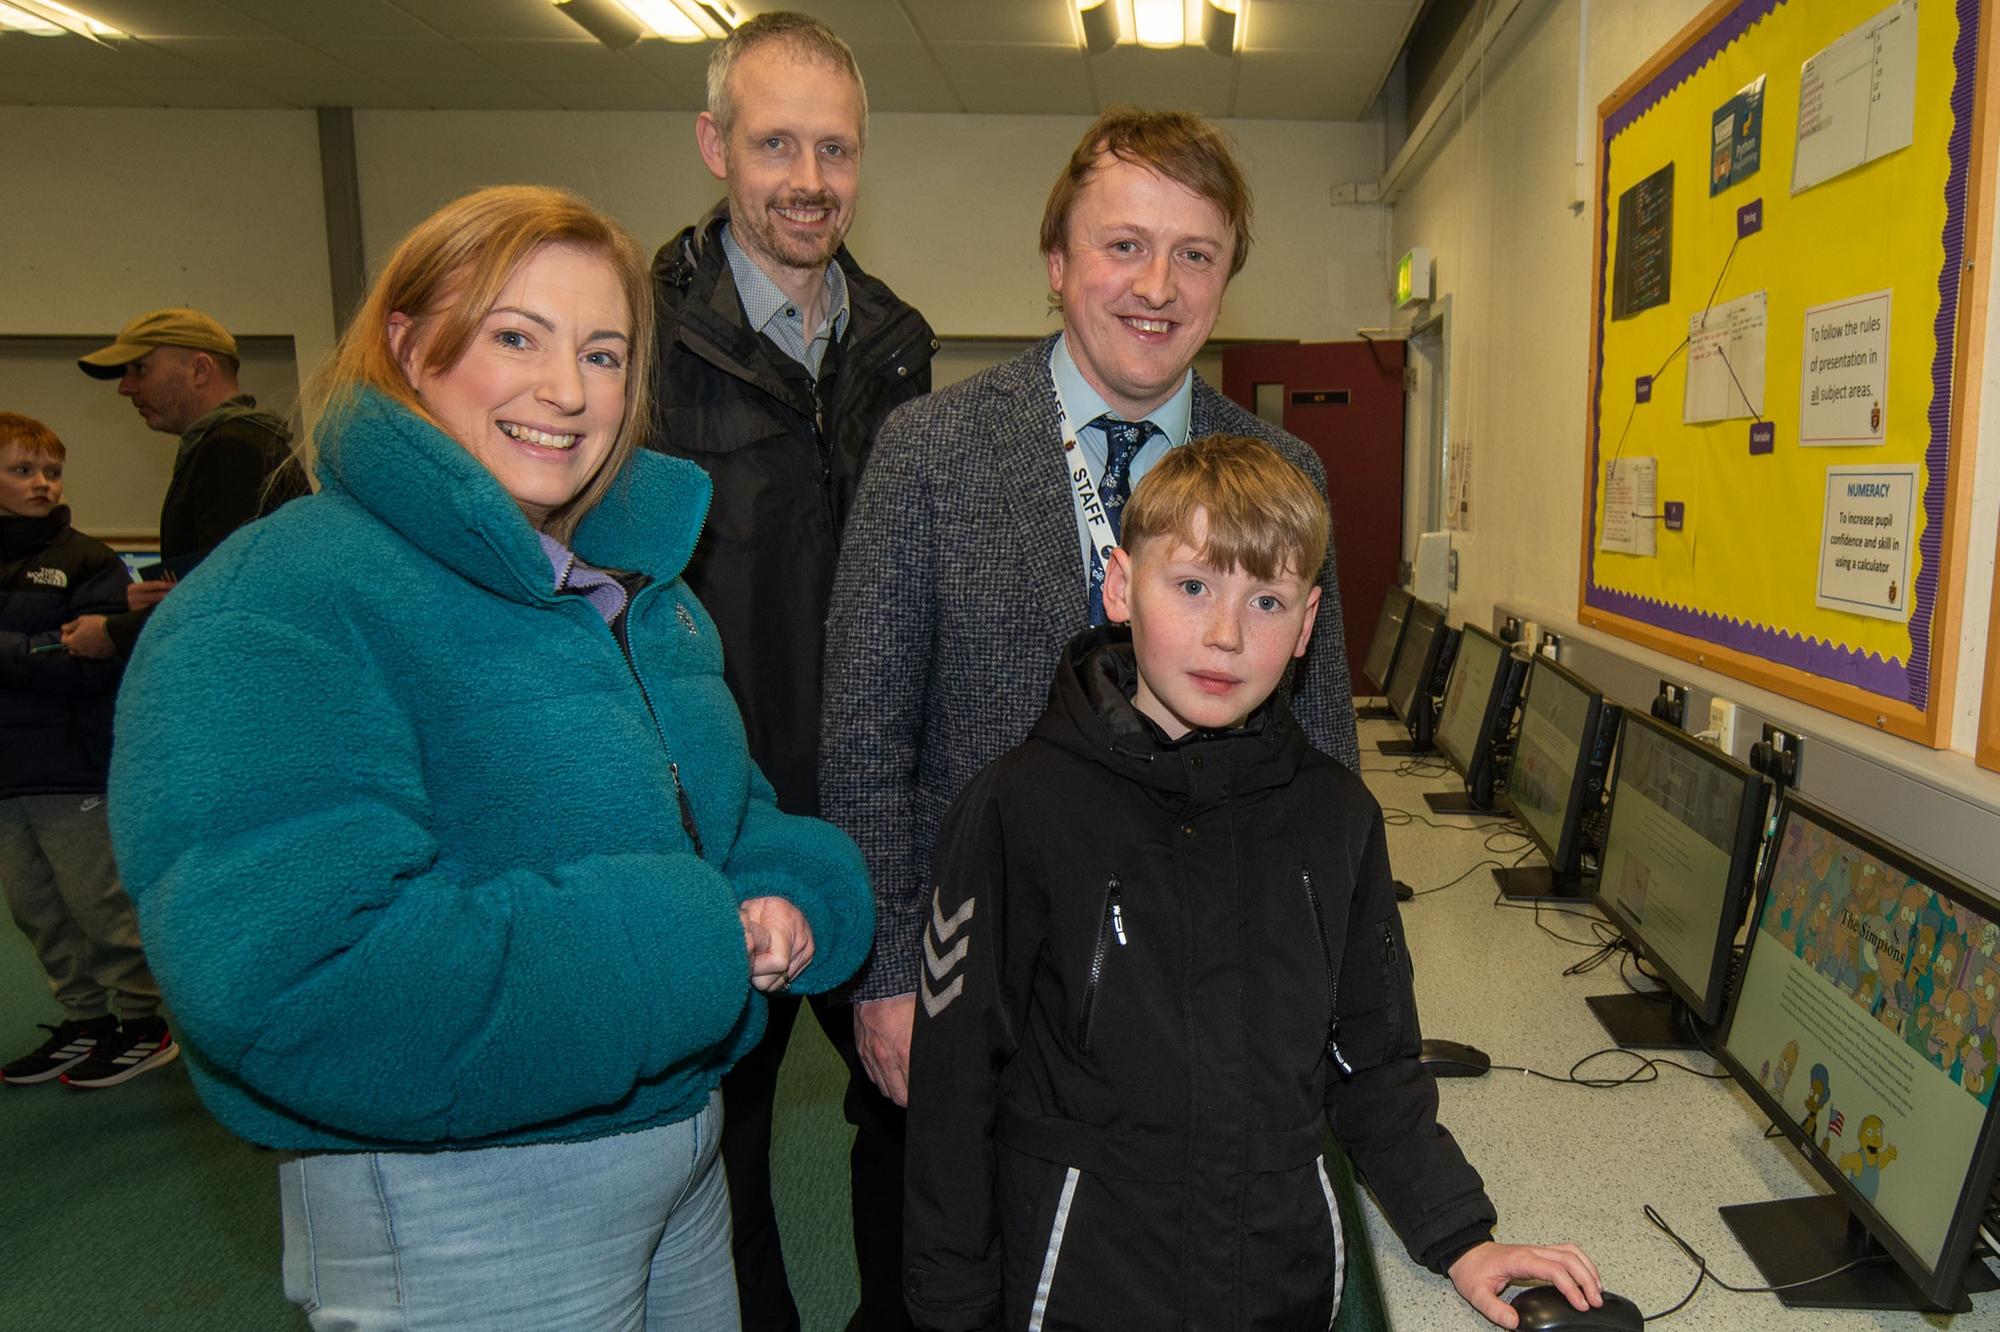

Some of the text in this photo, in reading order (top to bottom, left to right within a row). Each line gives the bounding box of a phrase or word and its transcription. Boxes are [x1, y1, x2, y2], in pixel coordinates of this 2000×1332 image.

[1811, 315, 1881, 342] To follow the rules
[1810, 348, 1877, 374] of presentation in
[1811, 384, 1873, 404] all subject areas.
[1073, 467, 1106, 528] STAFF
[1847, 483, 1890, 498] NUMERACY
[1839, 511, 1893, 529] To increase pupil
[1830, 533, 1900, 551] confidence and skill in
[1835, 556, 1851, 571] using
[1857, 558, 1890, 574] calculator
[1841, 907, 1906, 965] The Simpsons
